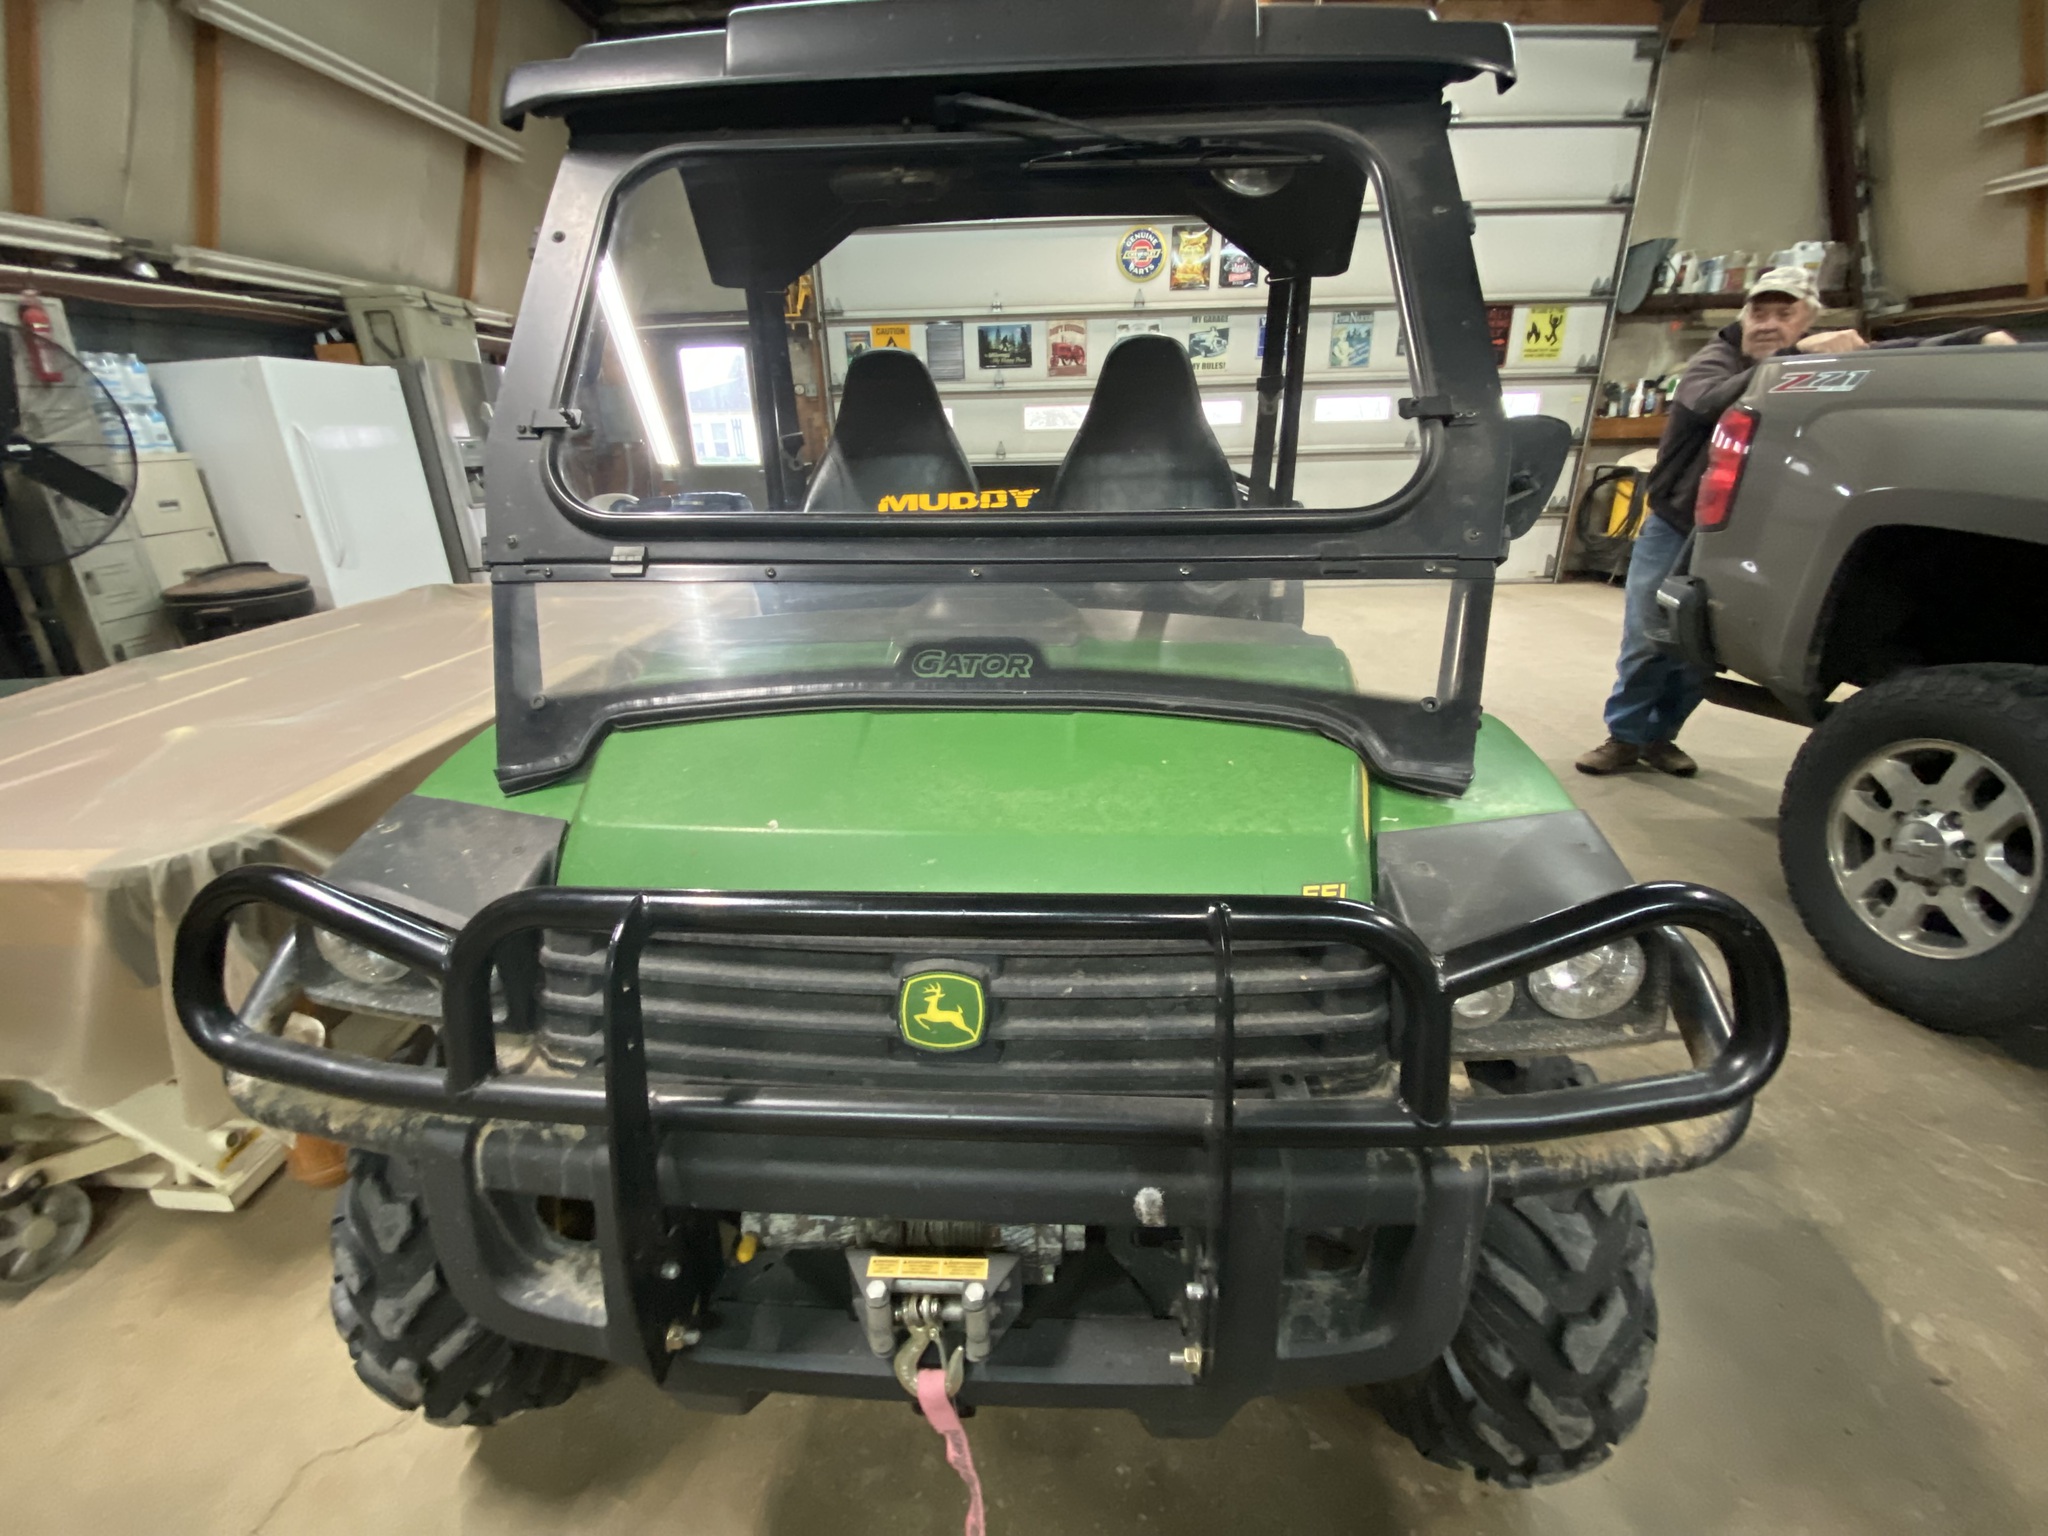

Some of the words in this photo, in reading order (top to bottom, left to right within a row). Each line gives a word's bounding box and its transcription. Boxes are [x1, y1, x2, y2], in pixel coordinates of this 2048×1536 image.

[1126, 232, 1159, 247] GENUINE
[1129, 262, 1155, 275] PARTS
[1192, 315, 1203, 323] MY
[1203, 315, 1229, 323] GARAGE
[876, 327, 906, 335] CAUTION
[1202, 362, 1226, 370] RULES!
[1768, 370, 1873, 393] Z71
[878, 488, 1041, 512] MUDDY
[912, 649, 1034, 678] GATOR
